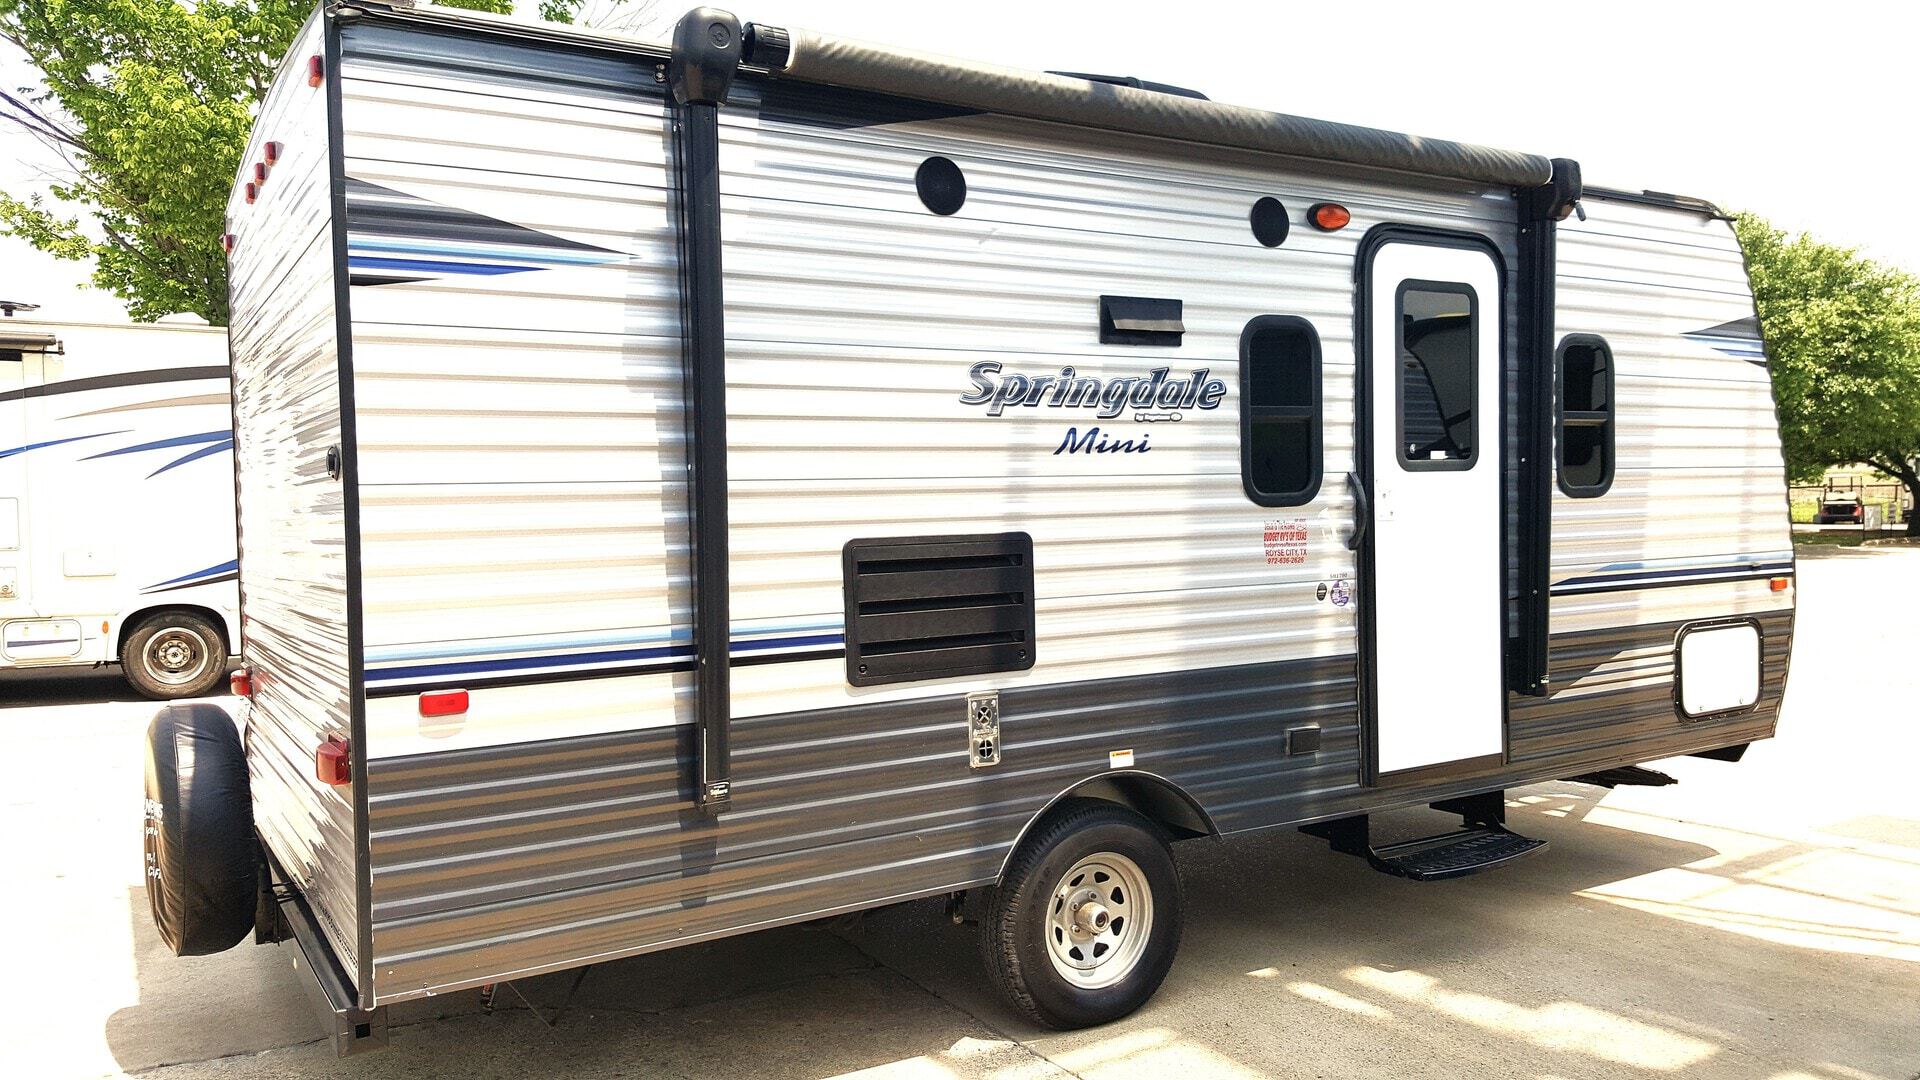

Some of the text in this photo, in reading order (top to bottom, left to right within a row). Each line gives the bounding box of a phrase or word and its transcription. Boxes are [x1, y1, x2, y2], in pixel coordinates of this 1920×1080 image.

[959, 361, 1226, 418] Springdale
[1053, 427, 1151, 455] Mini
[1296, 531, 1307, 540] TEXAS
[1265, 549, 1285, 557] ROYSE
[1300, 548, 1307, 556] TX
